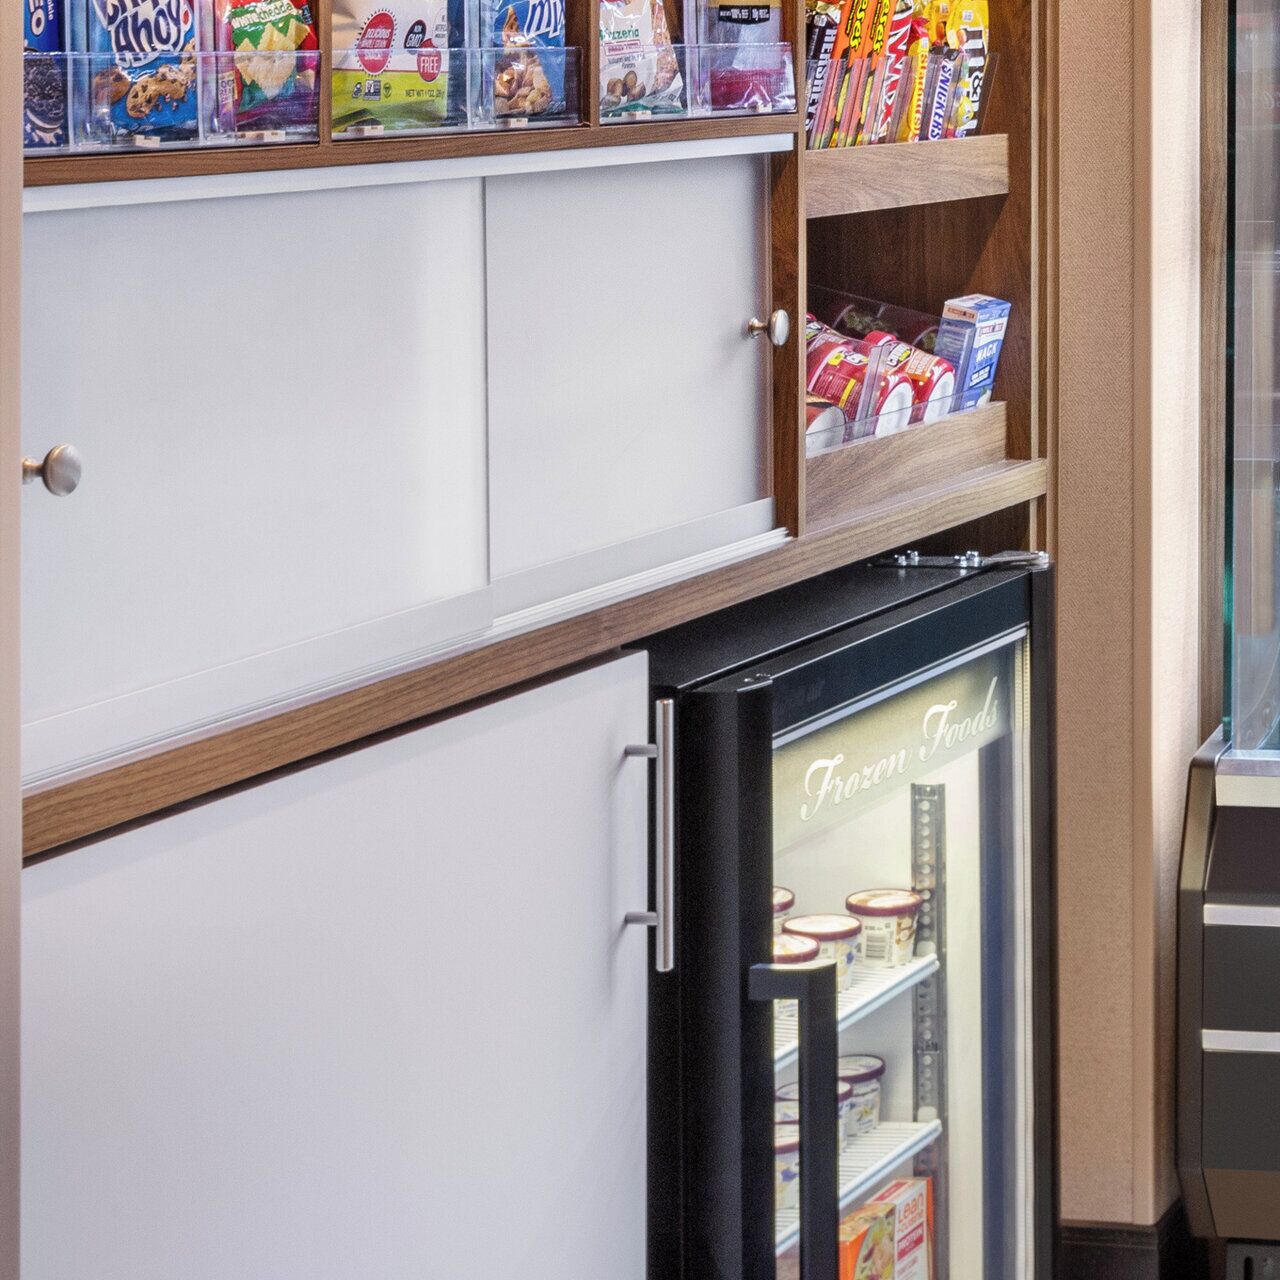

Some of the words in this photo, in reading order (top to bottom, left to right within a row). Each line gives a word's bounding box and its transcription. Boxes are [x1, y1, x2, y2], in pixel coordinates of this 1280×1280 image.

[420, 56, 439, 73] FREE
[805, 28, 837, 131] HERSHEY'S
[879, 12, 913, 128] TWIX
[929, 59, 953, 141] SNICKERS
[800, 753, 914, 821] Frozen
[919, 676, 998, 762] Foods
